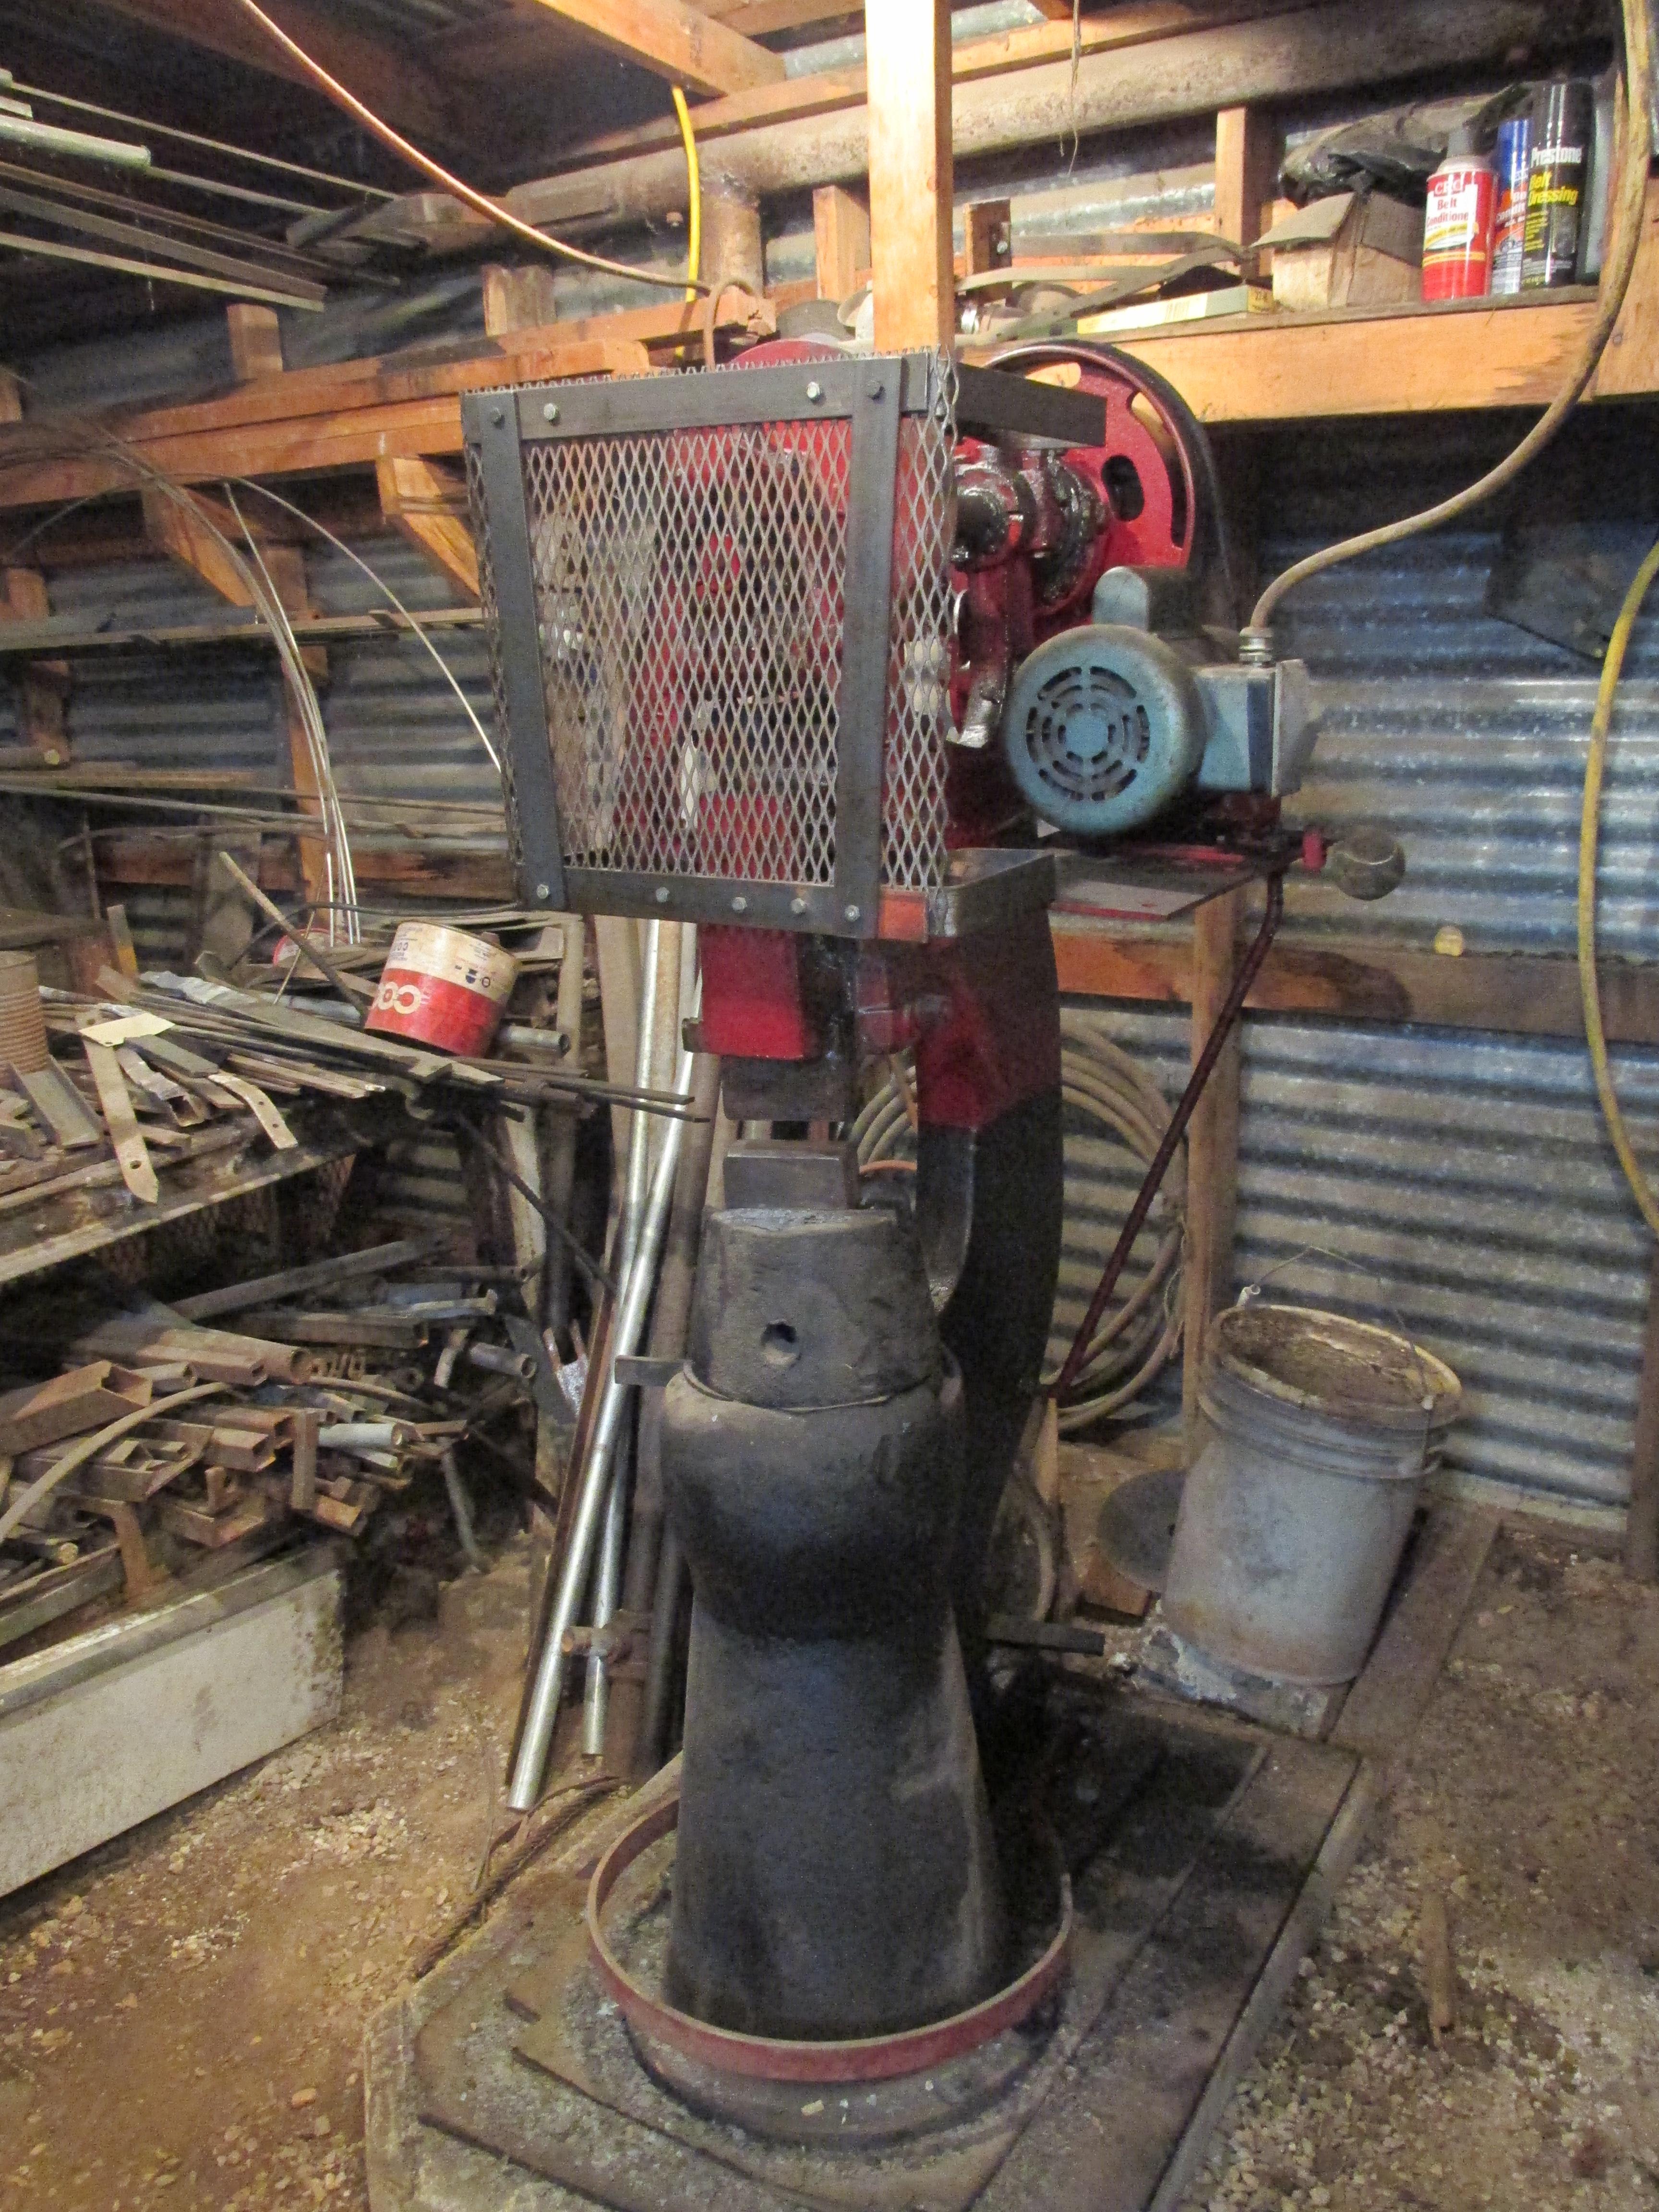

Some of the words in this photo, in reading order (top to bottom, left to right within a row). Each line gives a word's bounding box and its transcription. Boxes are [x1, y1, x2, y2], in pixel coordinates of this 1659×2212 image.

[1531, 146, 1582, 168] Prestone
[1528, 170, 1552, 191] Belt
[1438, 197, 1457, 210] Belt
[1527, 185, 1579, 207] Dressing
[1427, 212, 1469, 228] Conditione
